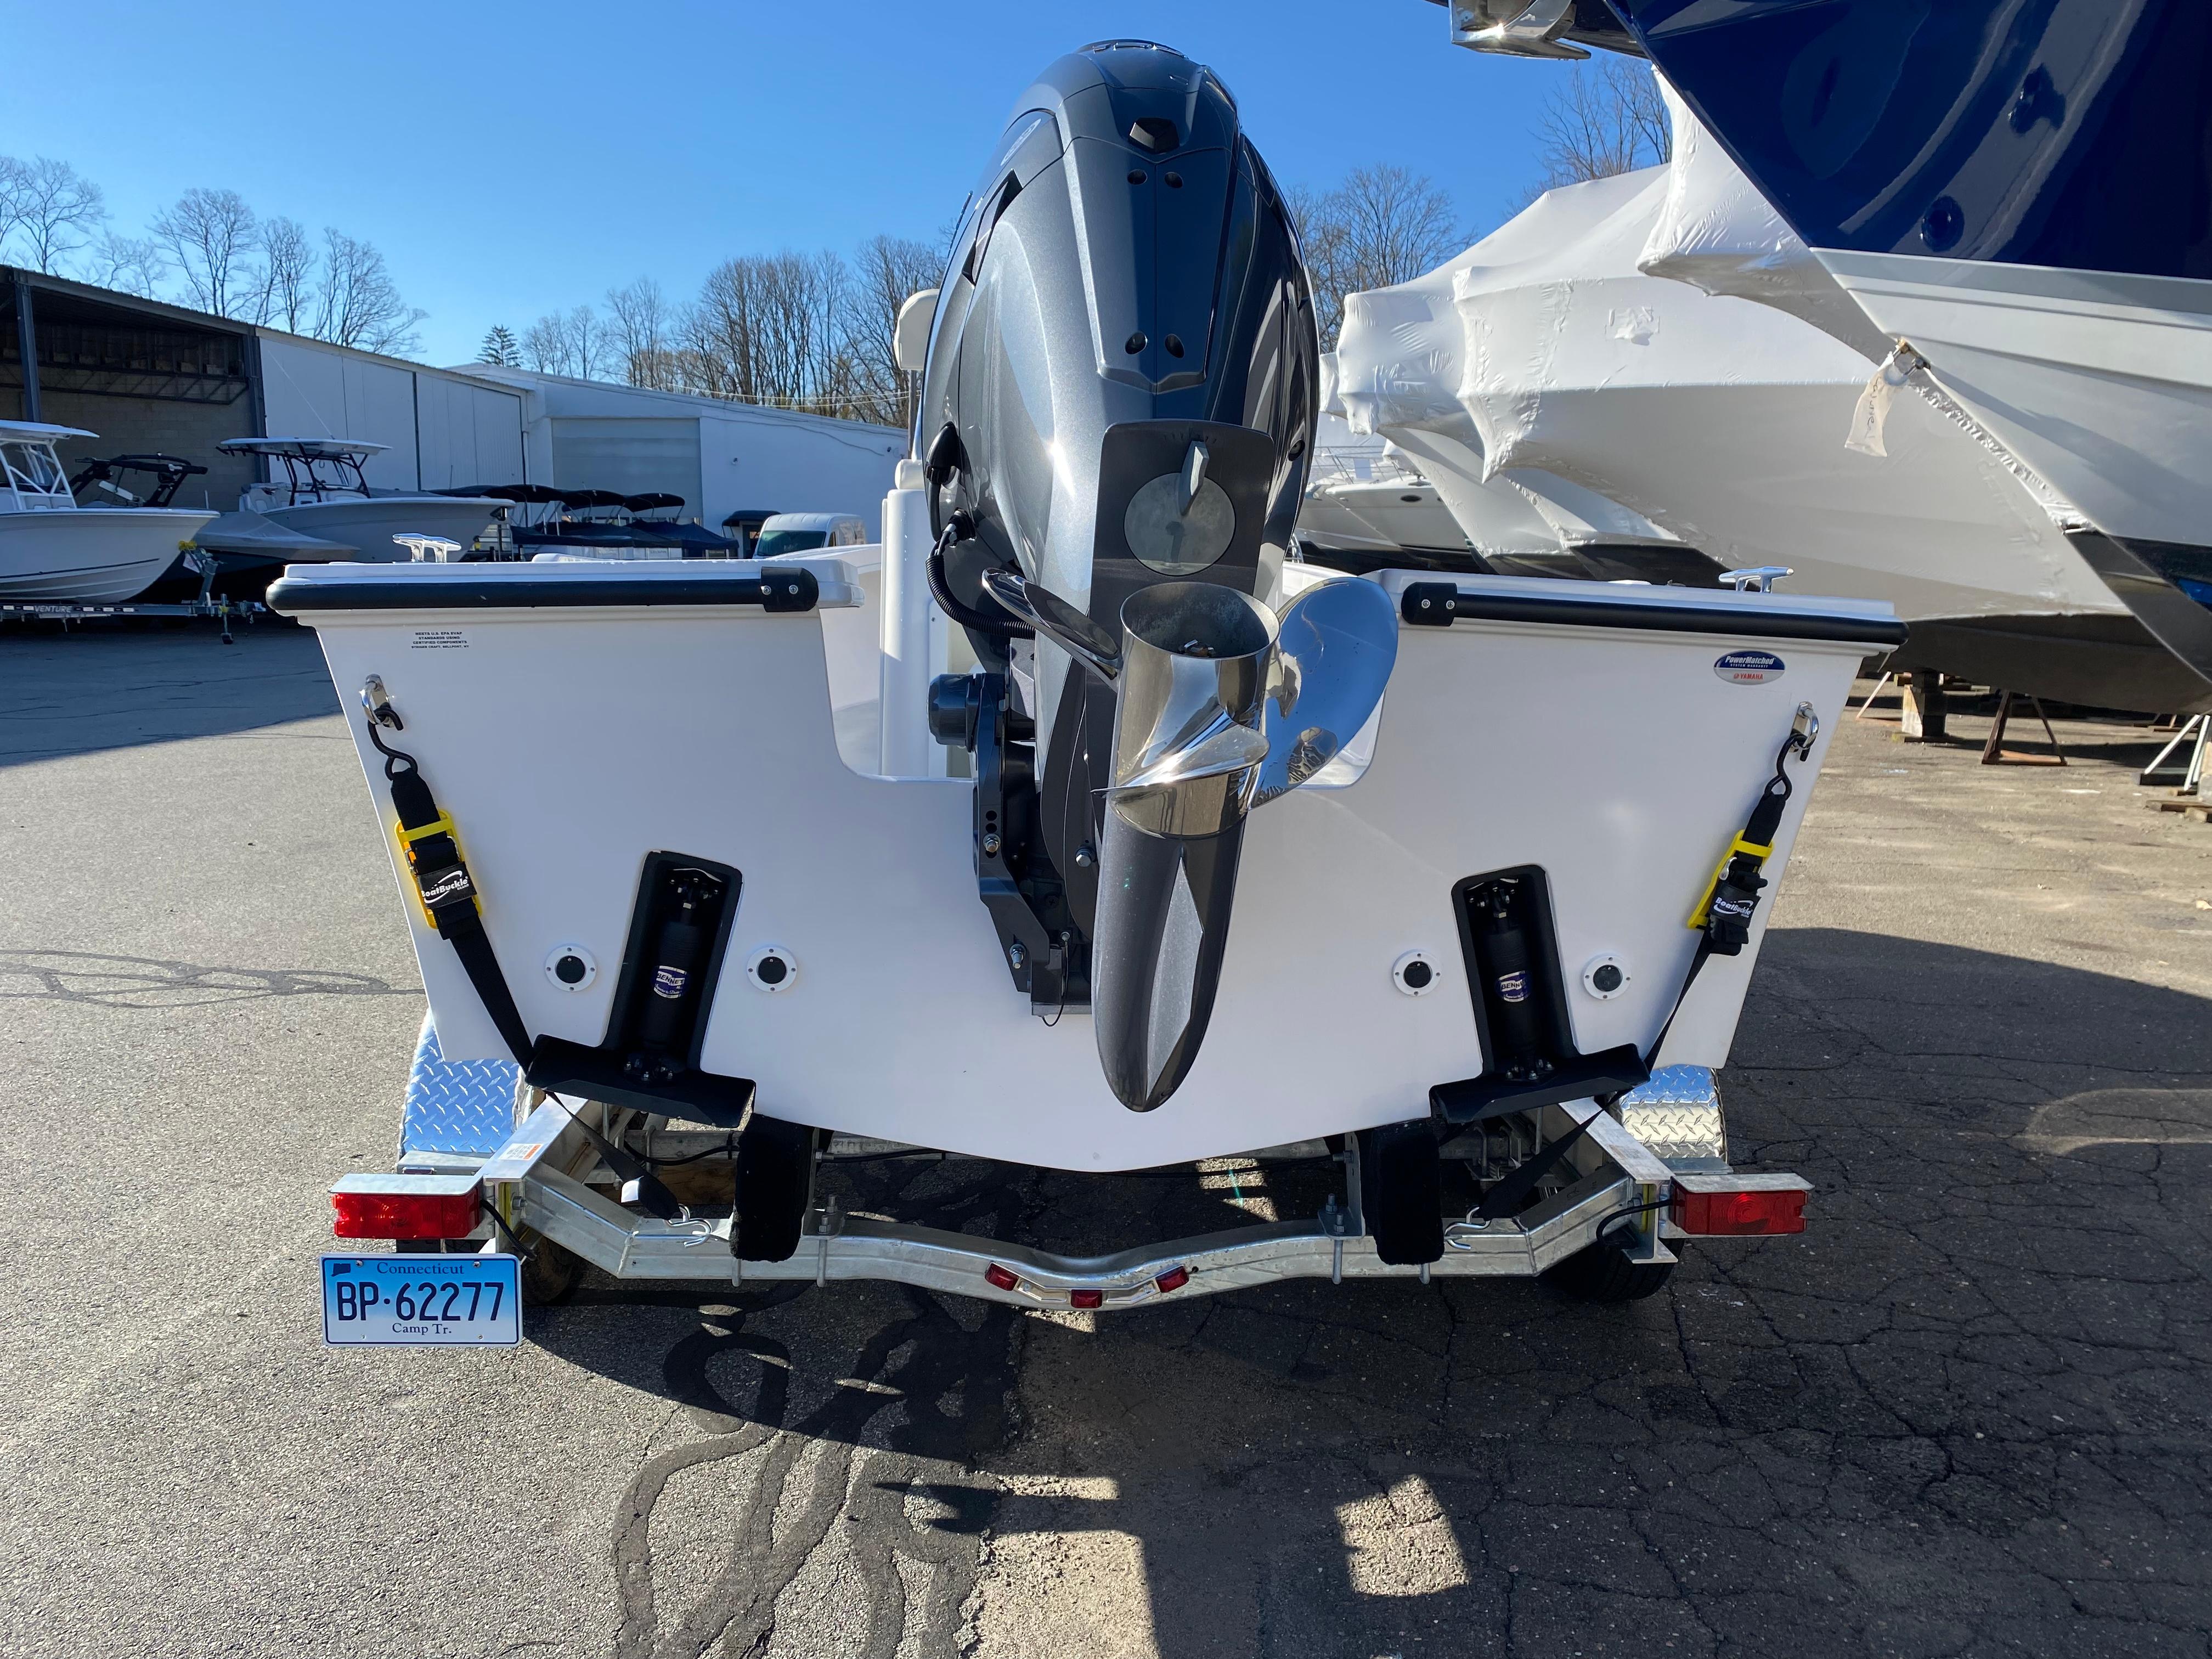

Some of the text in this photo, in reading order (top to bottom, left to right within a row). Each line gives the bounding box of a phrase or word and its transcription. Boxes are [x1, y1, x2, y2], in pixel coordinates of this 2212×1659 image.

[1725, 656, 1775, 664] PowerMatched
[377, 1262, 464, 1274] Connecticut
[392, 1323, 452, 1335] Camp Tr.
